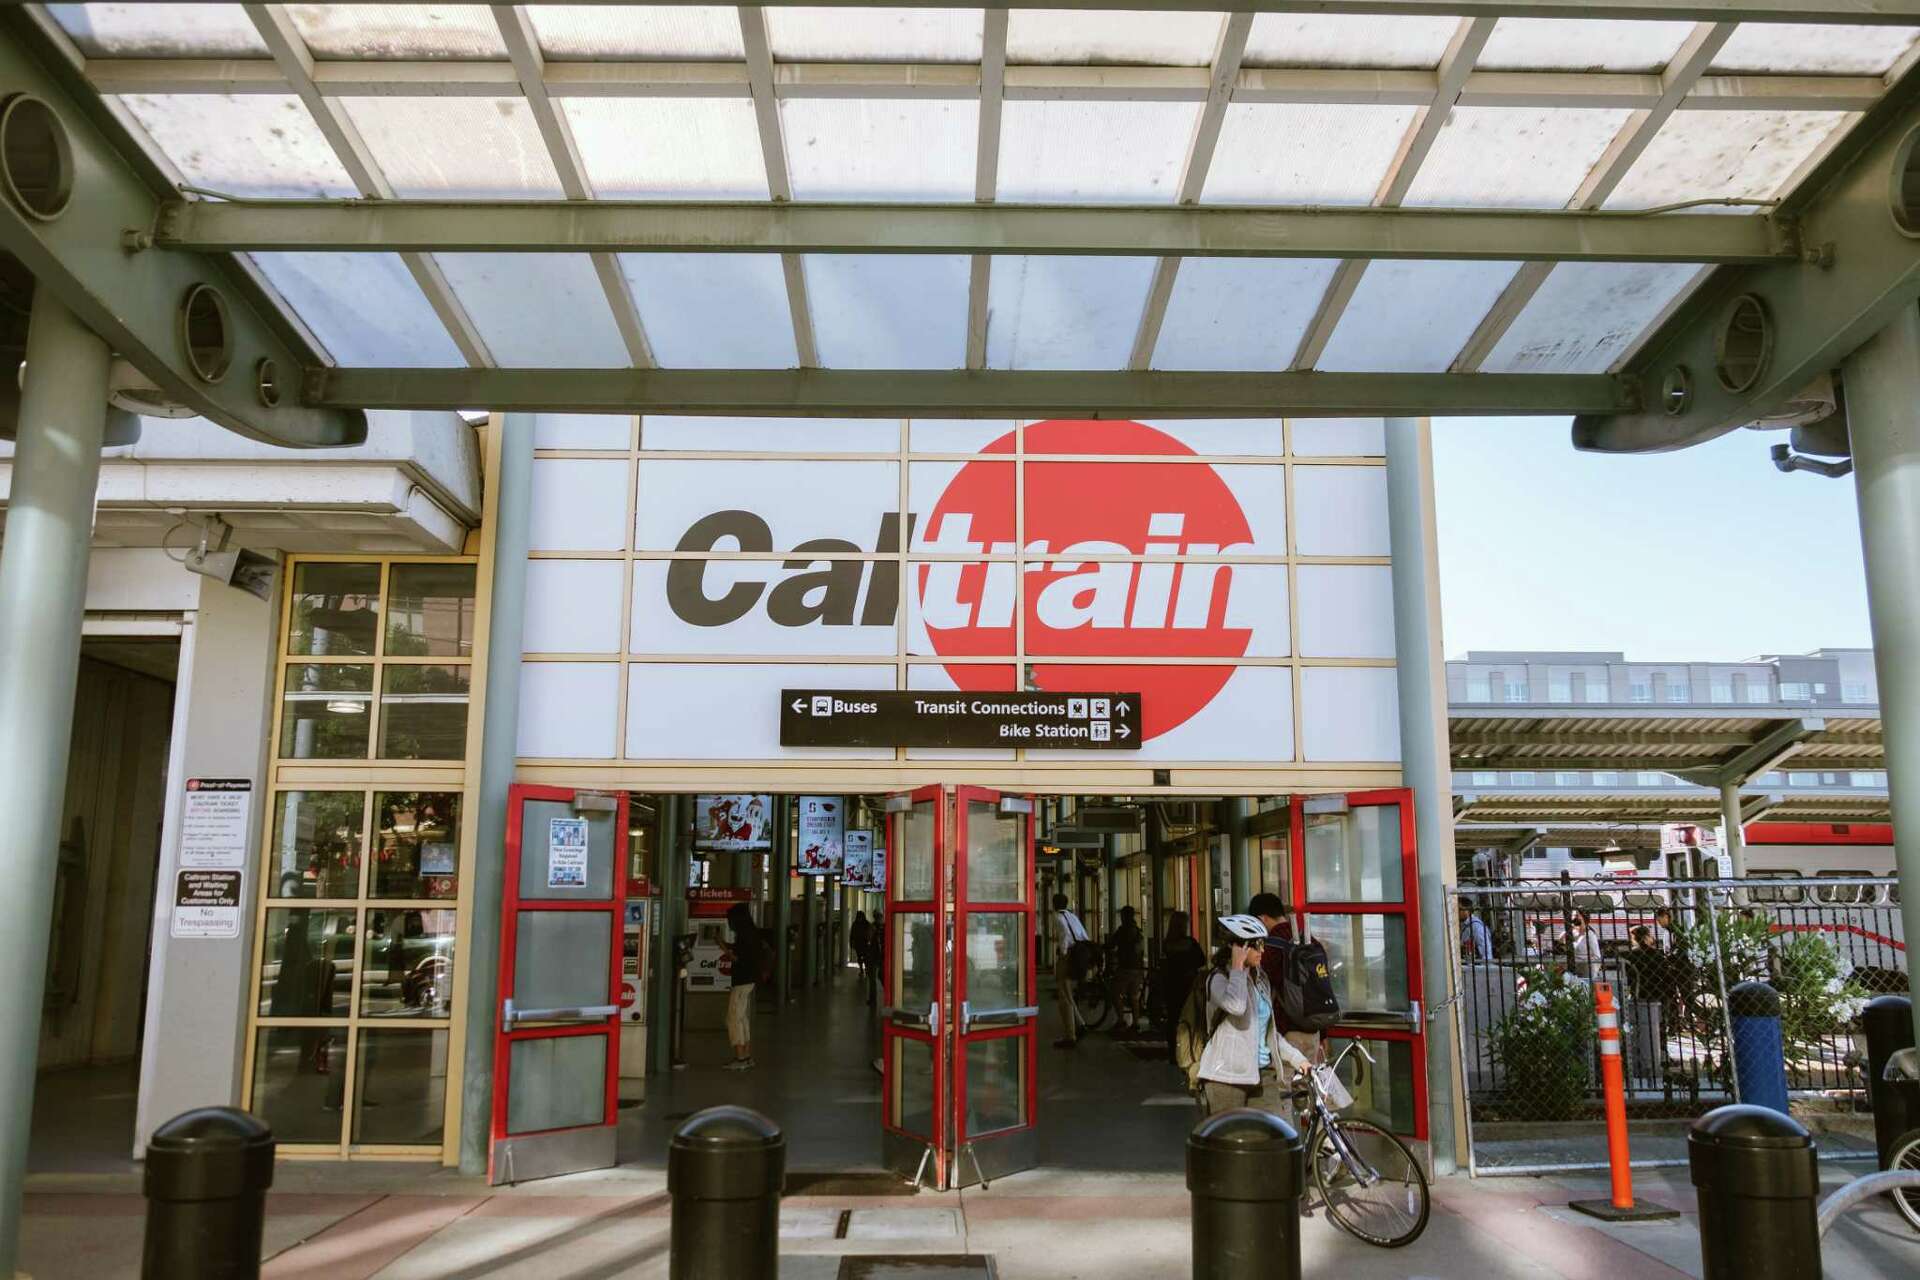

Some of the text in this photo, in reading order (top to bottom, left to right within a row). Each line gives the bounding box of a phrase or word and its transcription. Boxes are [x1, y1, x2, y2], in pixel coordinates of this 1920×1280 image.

[666, 509, 1255, 629] Caltrain
[834, 700, 877, 714] Buses
[915, 700, 1065, 715] Transit Connections
[1000, 723, 1088, 738] Bike Station
[211, 873, 236, 881] Station
[203, 882, 228, 890] Waiting
[193, 889, 224, 897] Areas for
[700, 888, 733, 898] tickets
[181, 897, 235, 905] Customers Only
[200, 908, 214, 917] No
[180, 917, 233, 928] Trespassing
[700, 959, 732, 969] Caltra
